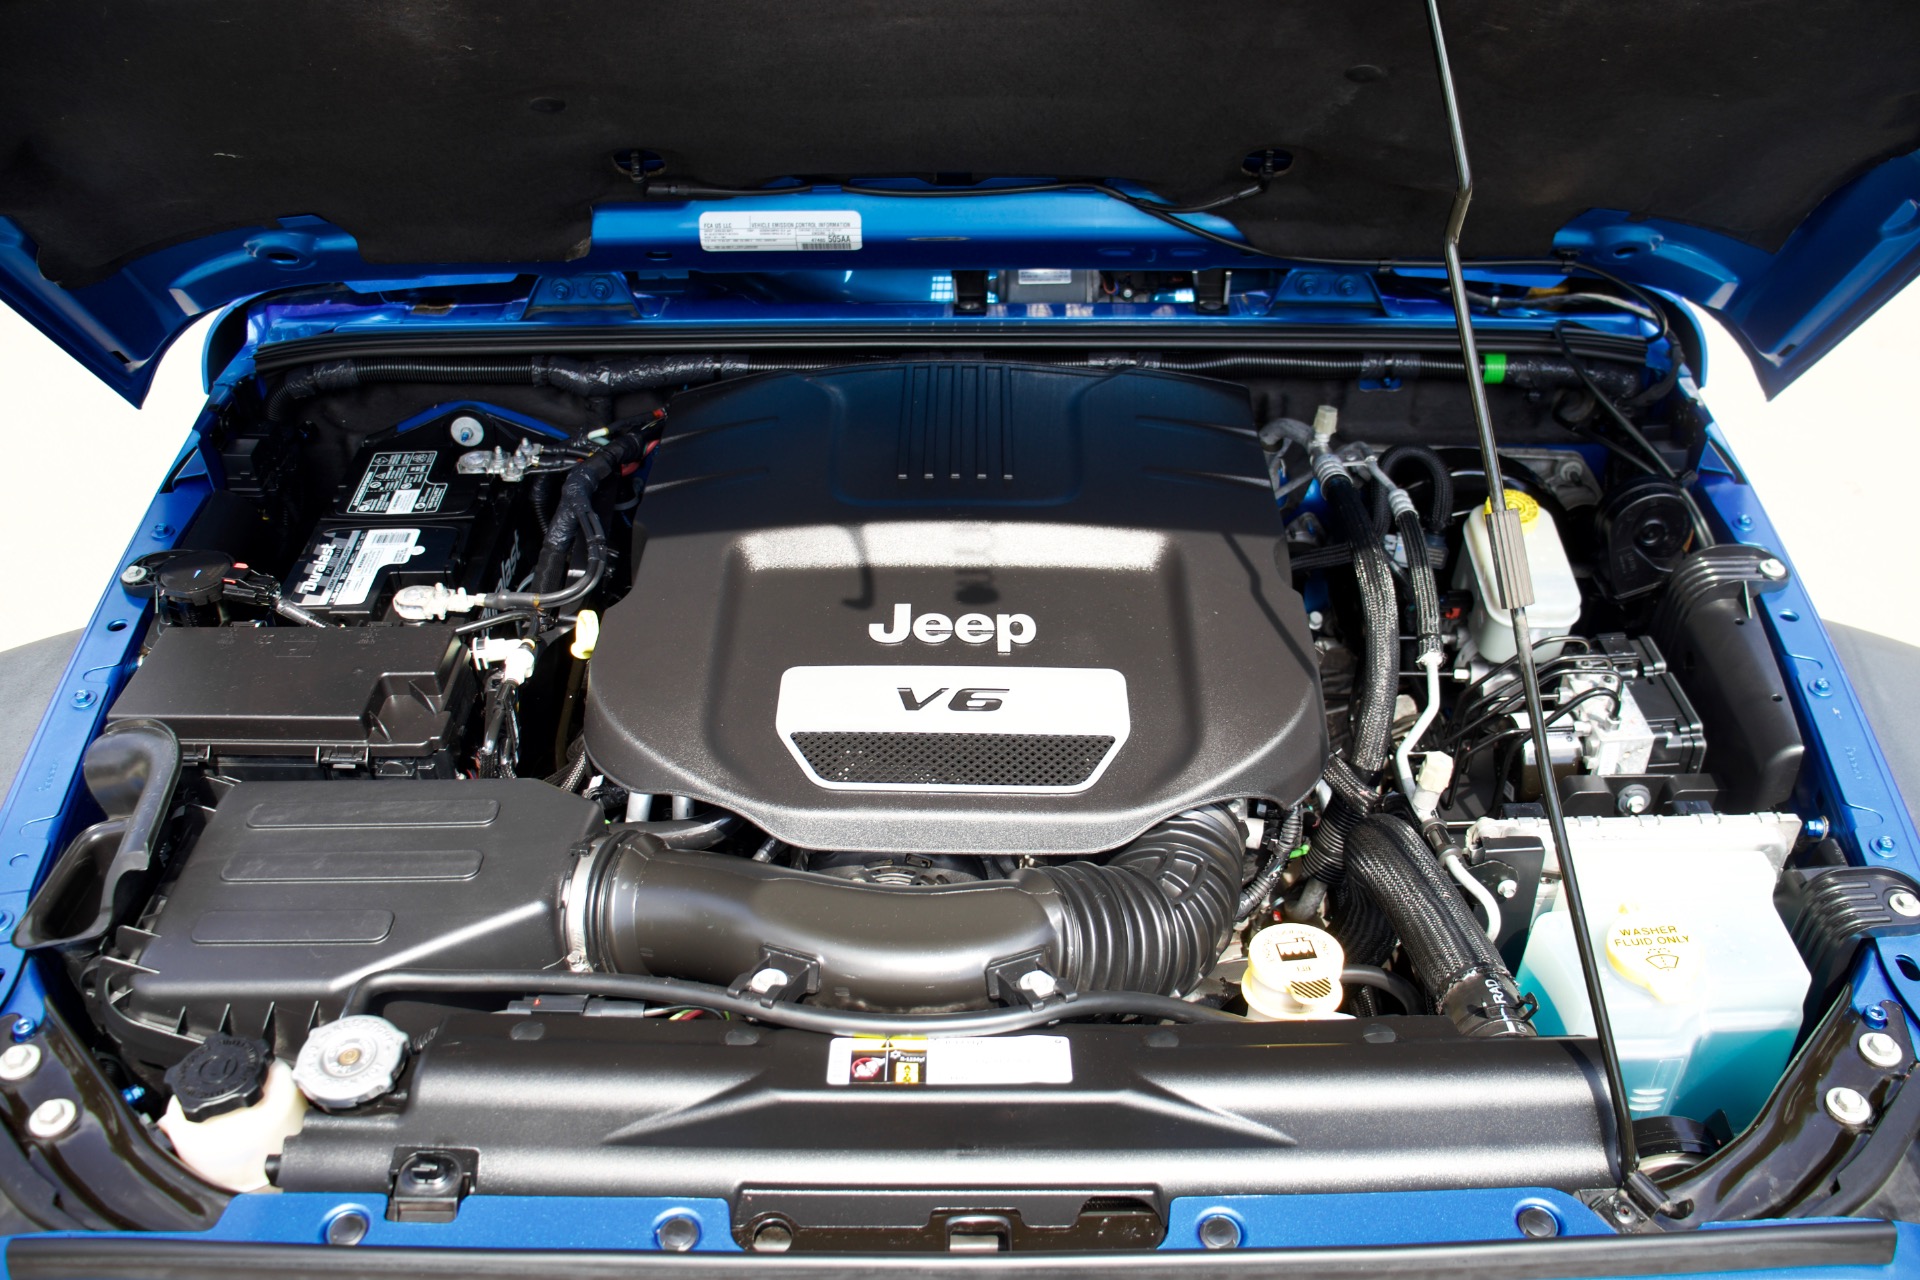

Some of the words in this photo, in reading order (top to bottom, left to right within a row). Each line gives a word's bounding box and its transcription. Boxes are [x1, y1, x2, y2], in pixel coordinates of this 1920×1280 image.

[298, 543, 337, 593] Duralast
[868, 603, 1037, 655] Jeep
[897, 687, 1010, 712] V6
[1614, 937, 1653, 947] FLUID
[1657, 935, 1689, 944] ONLY
[1619, 925, 1677, 936] WASHER
[1484, 979, 1507, 1004] RAD
